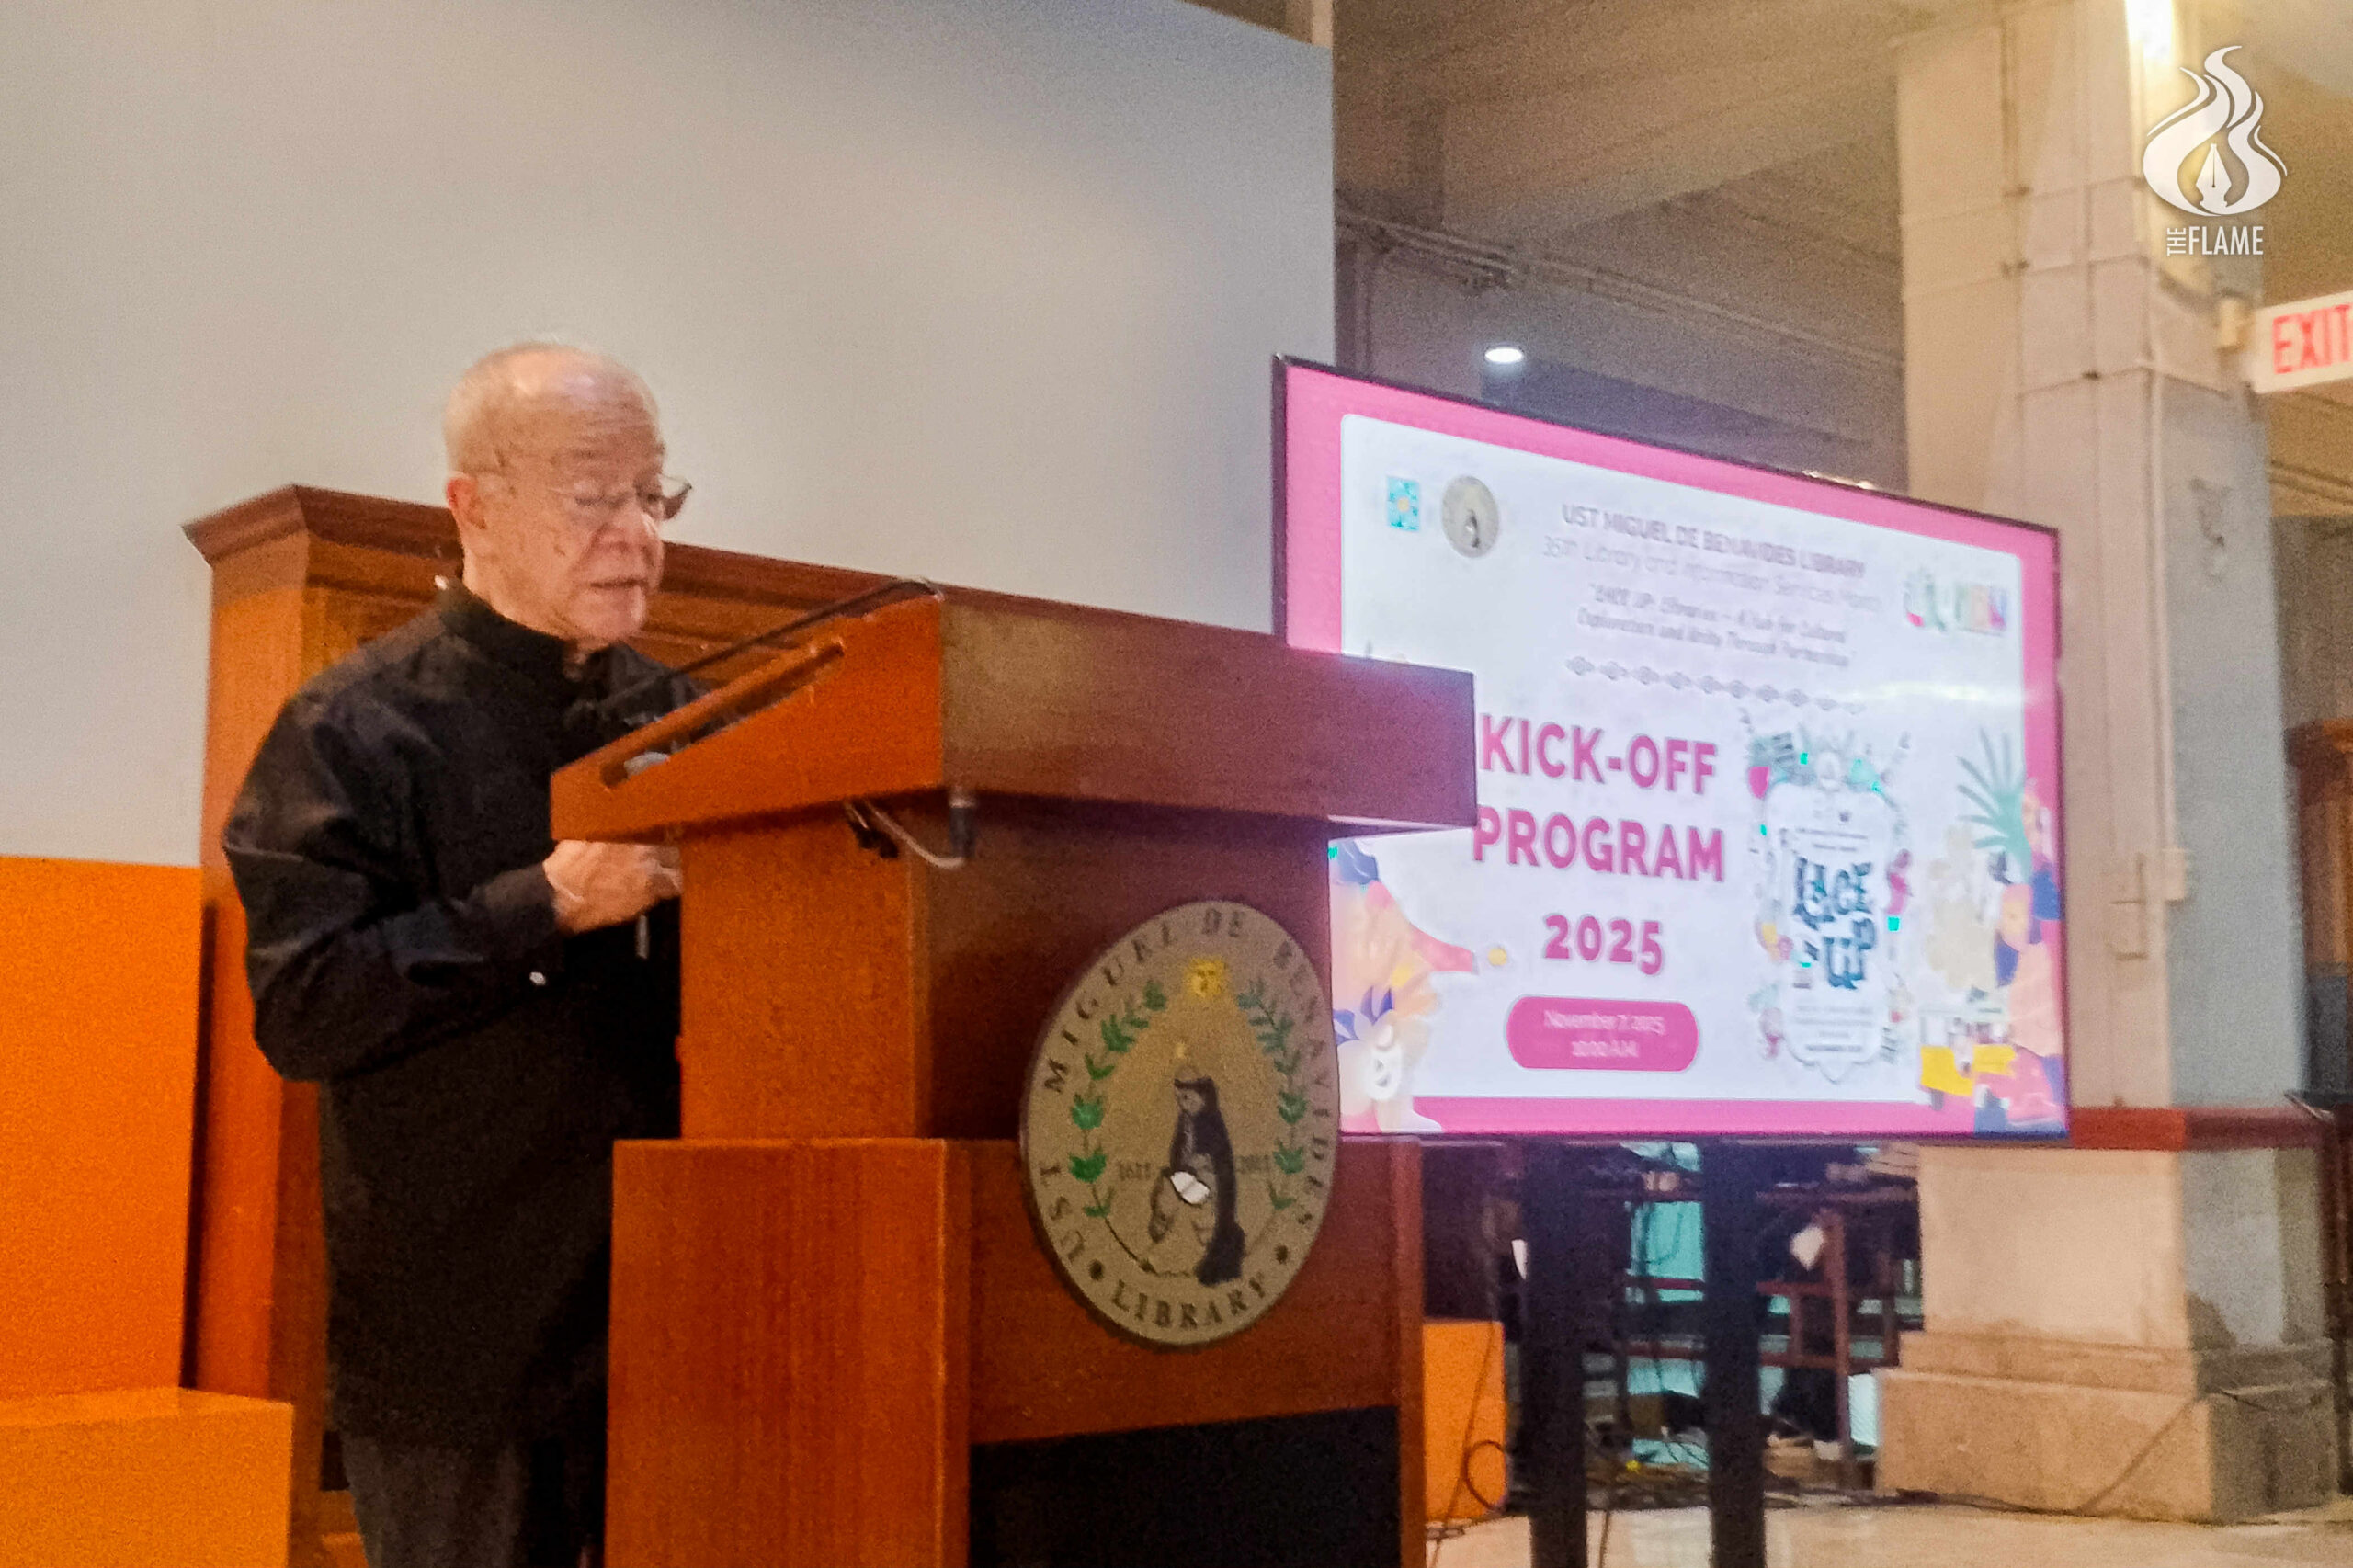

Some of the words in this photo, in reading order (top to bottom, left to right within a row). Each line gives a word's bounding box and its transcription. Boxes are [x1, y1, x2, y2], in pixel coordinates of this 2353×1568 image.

[2272, 304, 2352, 374] EXIT
[1482, 713, 1718, 794] KICK-OFF
[1472, 805, 1725, 882] PROGRAM
[1545, 914, 1664, 975] 2025
[1044, 921, 1177, 1093] MIGUEL
[1111, 1279, 1268, 1329] LIBRARY
